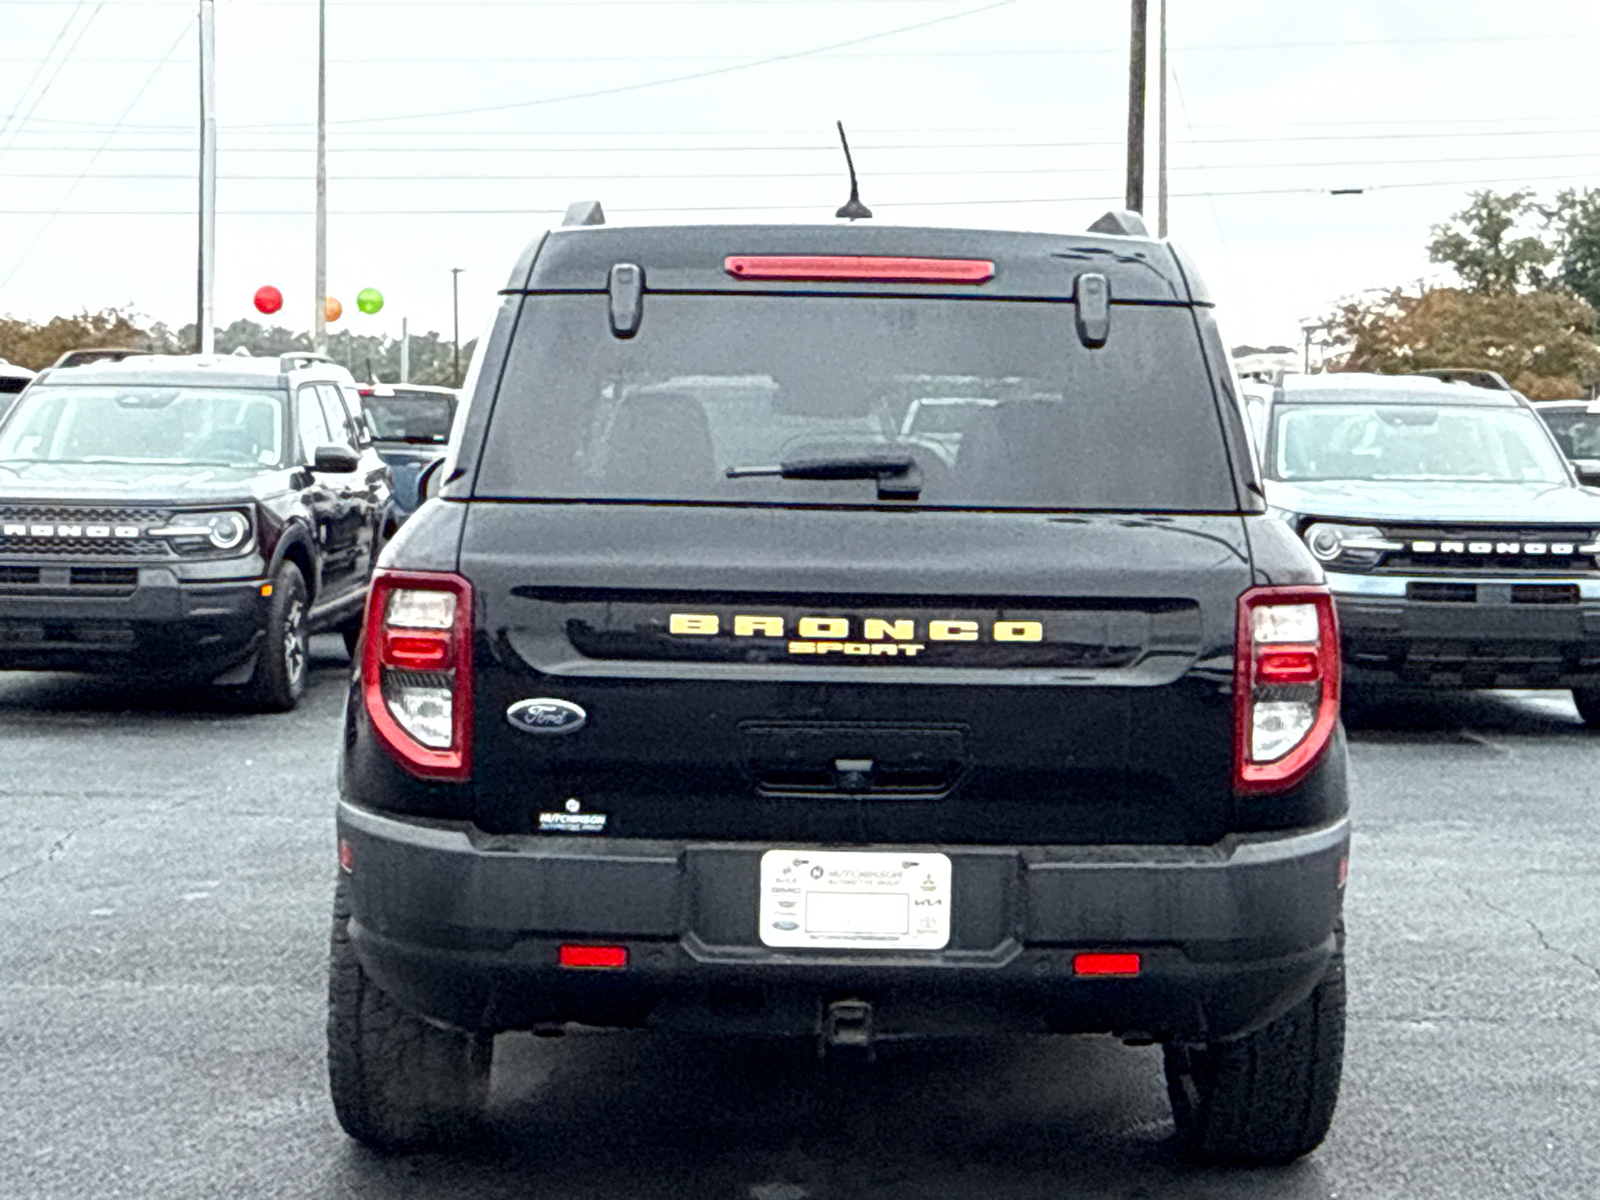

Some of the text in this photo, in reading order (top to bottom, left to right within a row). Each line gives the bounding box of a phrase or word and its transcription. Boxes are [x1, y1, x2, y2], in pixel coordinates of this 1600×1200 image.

[1412, 541, 1574, 554] BRONCO
[669, 613, 1043, 642] BRONCO
[788, 641, 926, 656] SPORT
[524, 705, 568, 725] Ford
